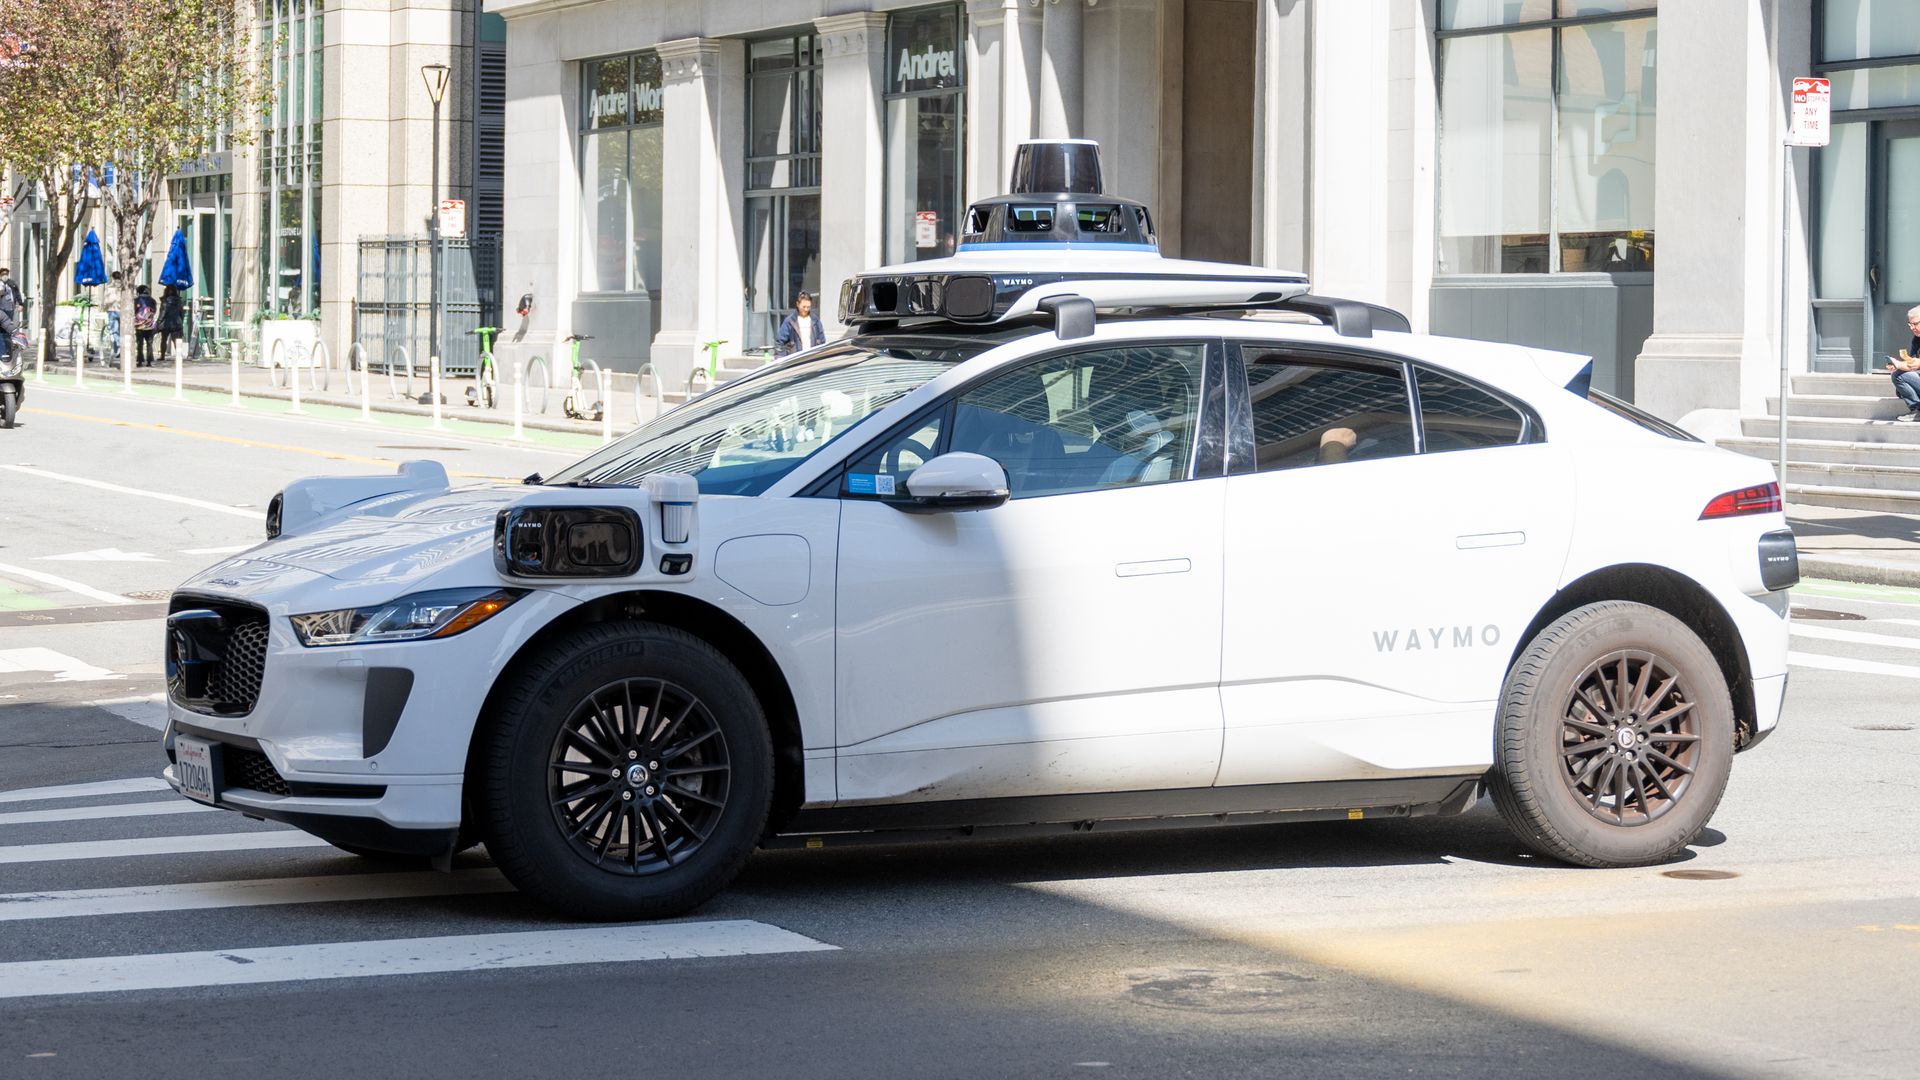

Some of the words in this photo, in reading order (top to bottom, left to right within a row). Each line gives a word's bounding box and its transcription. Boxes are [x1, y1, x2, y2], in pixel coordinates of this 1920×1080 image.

[589, 87, 628, 118] Andre
[635, 82, 664, 112] Wor
[1795, 94, 1806, 102] NO
[1804, 107, 1818, 117] ANY
[1803, 120, 1819, 130] TIME
[1372, 624, 1501, 652] WAYMO
